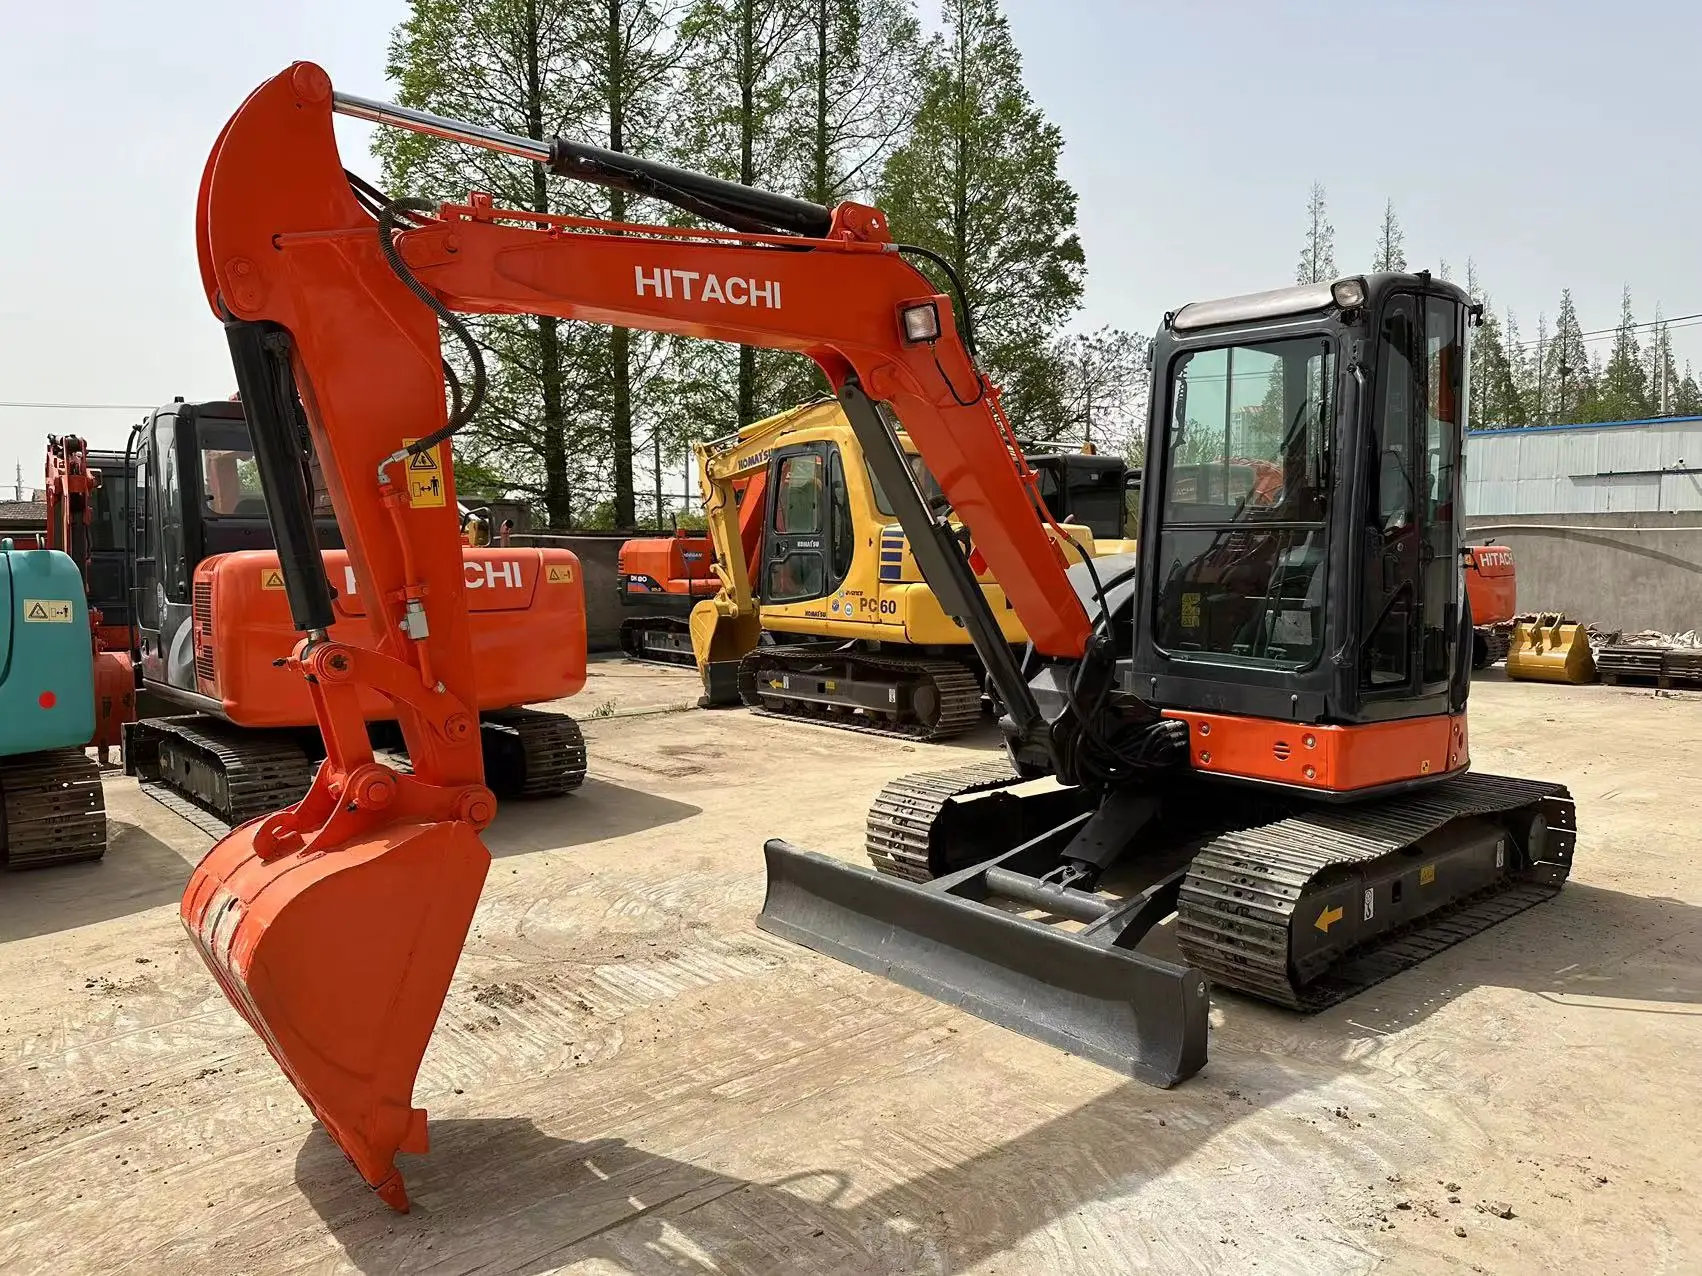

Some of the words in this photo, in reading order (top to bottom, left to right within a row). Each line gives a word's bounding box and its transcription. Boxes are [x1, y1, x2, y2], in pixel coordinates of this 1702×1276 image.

[634, 265, 782, 309] HITACHI
[797, 539, 820, 548] KOMATSU
[1480, 552, 1514, 567] HITACH
[804, 610, 827, 618] KOMATSU
